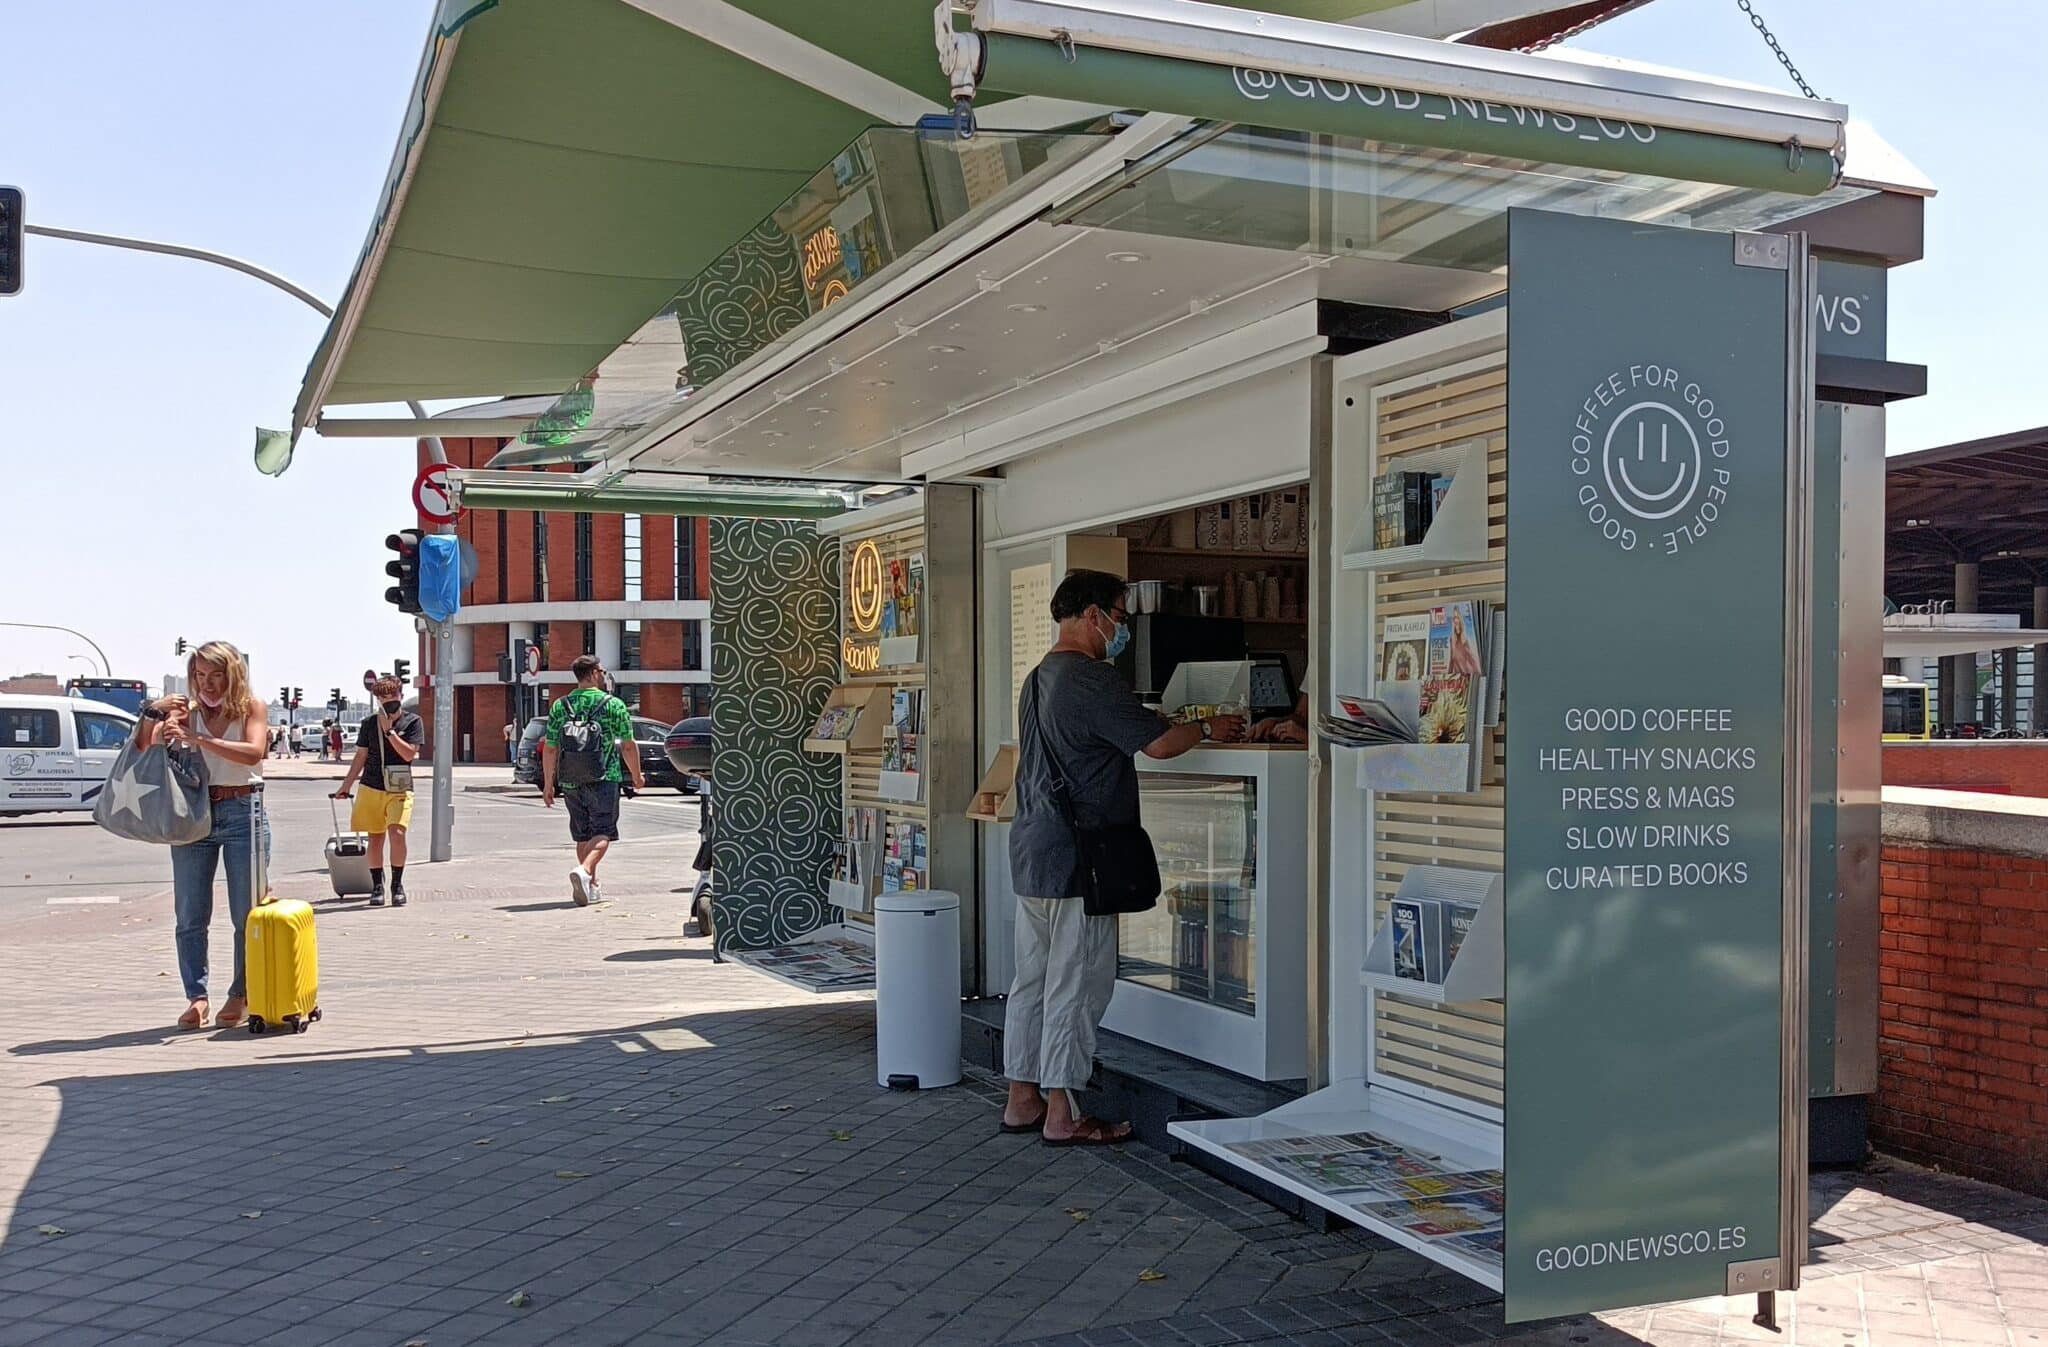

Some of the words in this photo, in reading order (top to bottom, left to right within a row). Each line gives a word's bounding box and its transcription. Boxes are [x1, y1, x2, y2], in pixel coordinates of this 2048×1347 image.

[1630, 365, 1678, 392] FOR
[1572, 372, 1626, 475] COFFEE
[1684, 383, 1729, 458] GOOD
[1579, 485, 1636, 551] GOOD
[1663, 468, 1730, 555] PEOPLE
[1901, 599, 1954, 615] adif
[1565, 708, 1636, 731] GOOD
[1642, 708, 1732, 731] COFFEE
[1539, 748, 1655, 771] HEALTHY
[1660, 747, 1756, 770] SNACKS
[1562, 787, 1639, 810] PRESS
[1645, 786, 1661, 809] &
[1668, 786, 1735, 808] MAGS
[1566, 826, 1637, 850] SLOW
[1643, 824, 1730, 848] DRINKS
[1546, 864, 1662, 890] CURATED
[1669, 862, 1748, 886] BOOKS
[1397, 909, 1413, 919] 100
[1536, 1226, 1746, 1272] GOODNEWSCO.ES
